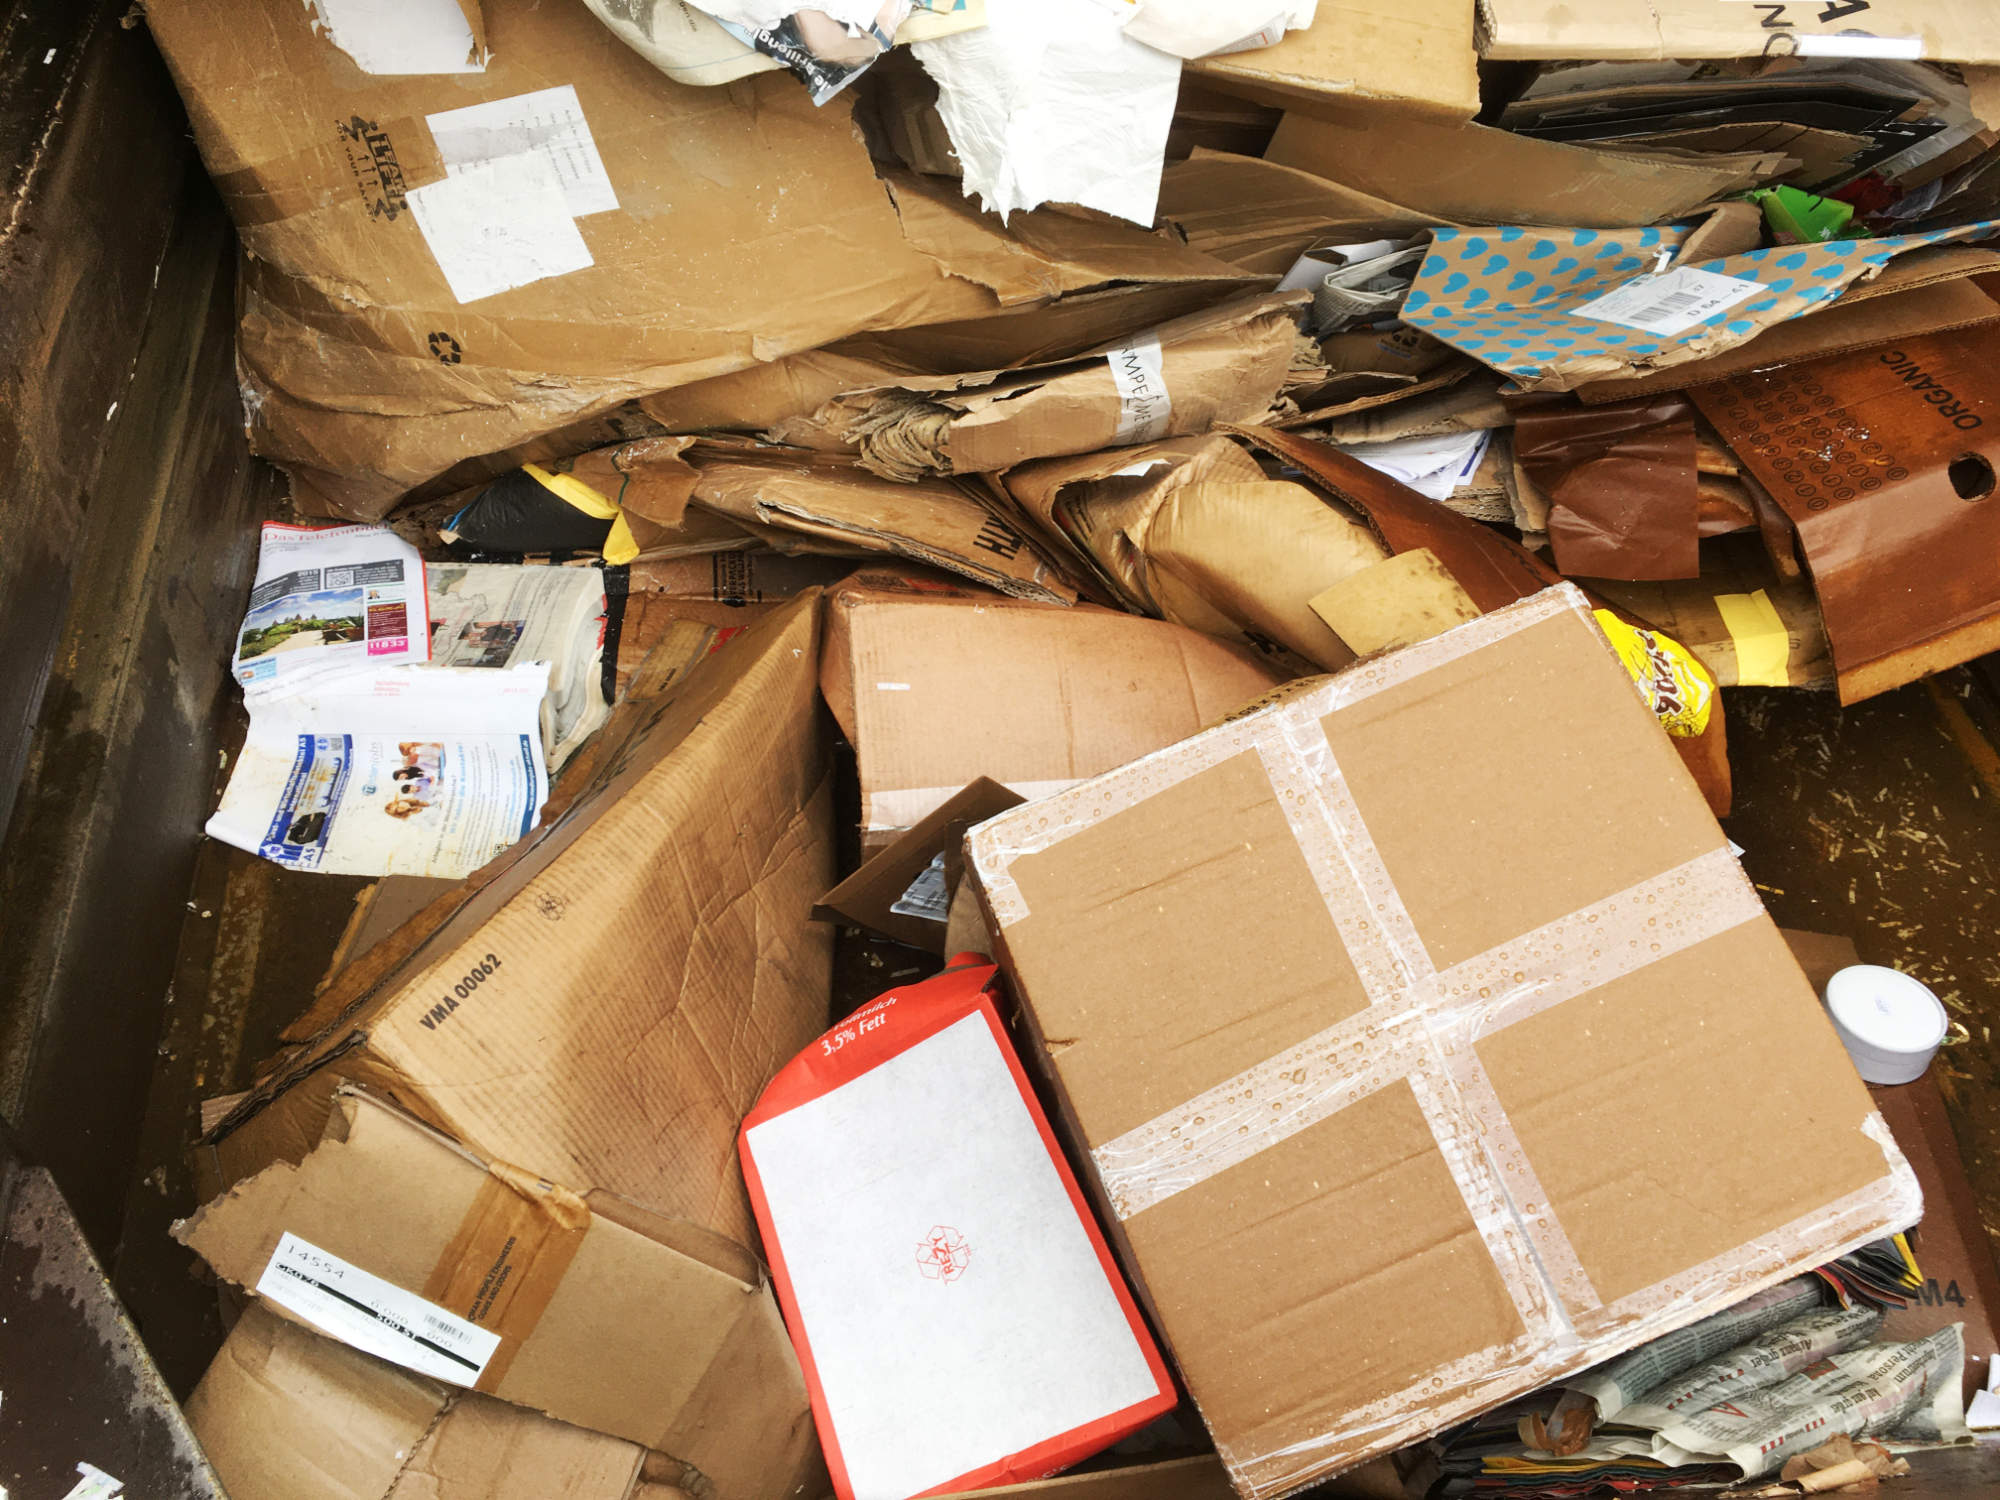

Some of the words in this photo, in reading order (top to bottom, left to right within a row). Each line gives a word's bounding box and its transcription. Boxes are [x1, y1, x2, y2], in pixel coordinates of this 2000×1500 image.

[346, 146, 359, 177] YOUR
[1880, 351, 1983, 431] ORGANIC
[304, 848, 316, 862] AS
[419, 995, 460, 1030] VMA
[454, 953, 502, 999] 00062
[821, 1027, 856, 1056] 3,5%
[859, 1013, 886, 1035] Fett
[289, 1244, 345, 1279] 14554
